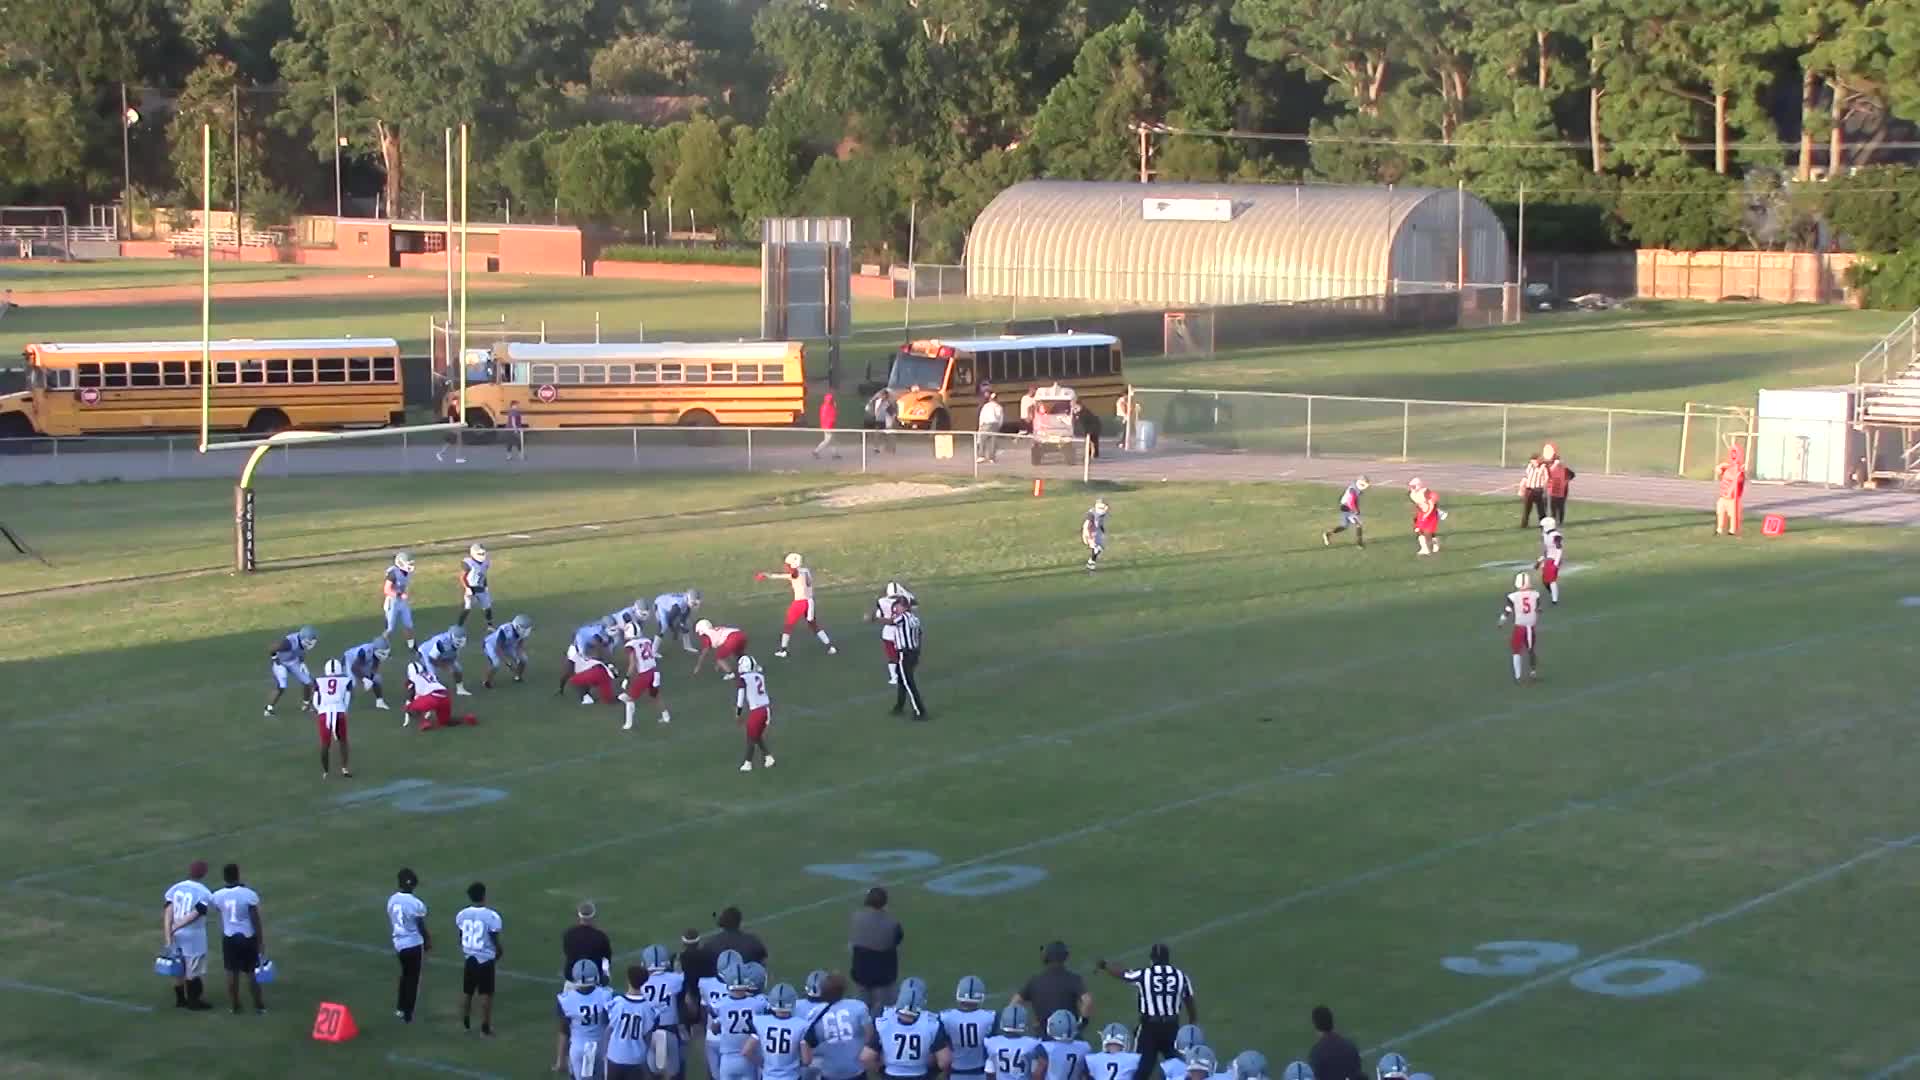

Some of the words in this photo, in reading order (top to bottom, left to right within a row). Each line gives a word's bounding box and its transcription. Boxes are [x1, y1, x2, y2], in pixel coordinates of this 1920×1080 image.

[1522, 597, 1531, 614] 5
[327, 679, 337, 696] 9
[755, 675, 765, 695] 2
[462, 919, 485, 950] 82
[1439, 939, 1706, 997] 30
[1153, 975, 1176, 992] 52
[316, 1007, 341, 1034] 20
[580, 1004, 598, 1026] 31
[620, 1013, 642, 1040] 70
[728, 1010, 753, 1034] 23
[766, 1027, 792, 1054] 56
[894, 1033, 921, 1060] 79
[959, 1023, 978, 1048] 10
[998, 1048, 1026, 1073] 54
